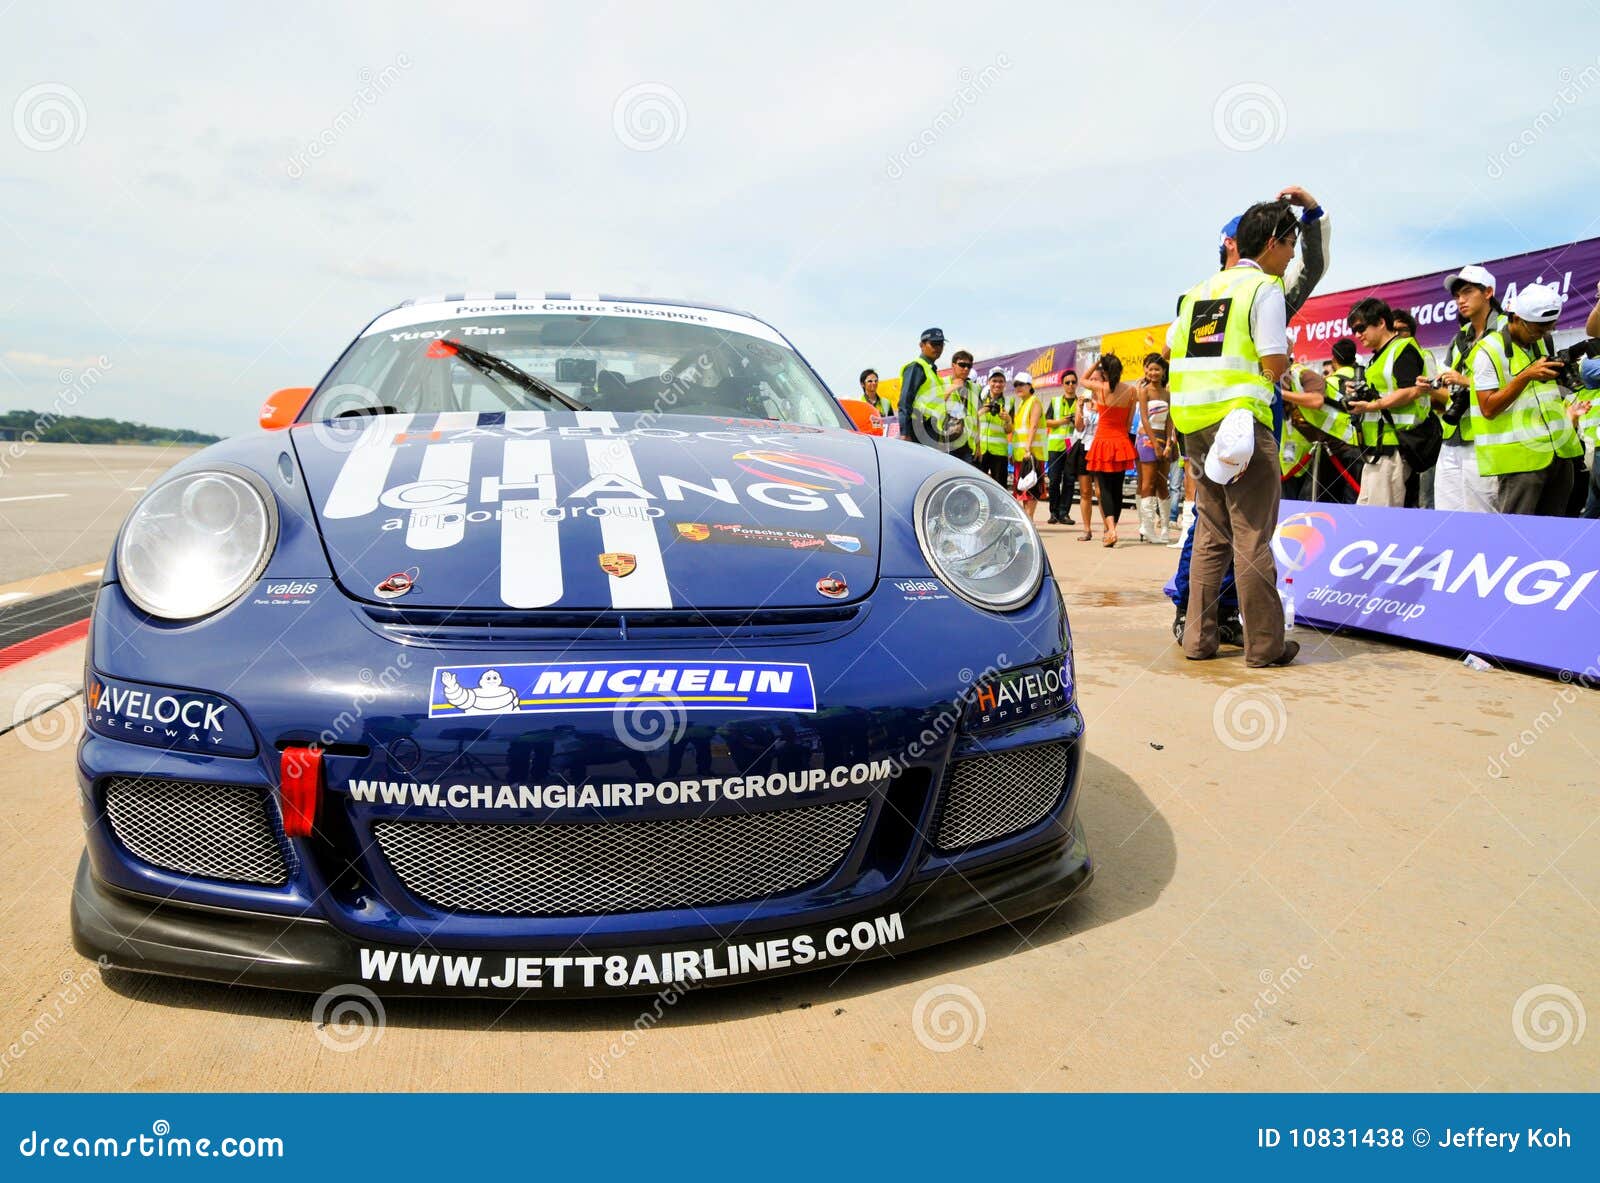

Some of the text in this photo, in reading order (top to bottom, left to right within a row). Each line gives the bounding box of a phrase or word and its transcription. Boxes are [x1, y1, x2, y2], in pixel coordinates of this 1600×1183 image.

[456, 302, 709, 323] Porsche Centre Singapore
[390, 326, 506, 342] Yuey Tan
[1306, 318, 1353, 342] versu
[381, 474, 865, 518] CHANGI
[382, 504, 665, 532] airport group
[733, 528, 783, 536] Porsche
[786, 531, 814, 539] Club
[266, 582, 318, 594] valais
[894, 580, 938, 591] valais
[1329, 540, 1598, 611] CHANGI
[1306, 585, 1426, 622] airport group
[532, 669, 793, 694] MICHELIN
[88, 680, 228, 732] HAVELOCK
[982, 695, 1063, 722] SPEEDW
[349, 759, 891, 809] WWW.CHANGIAIRPORTGROUP.COM
[360, 912, 905, 988] WWW.JETT8AIRLINES.COM
